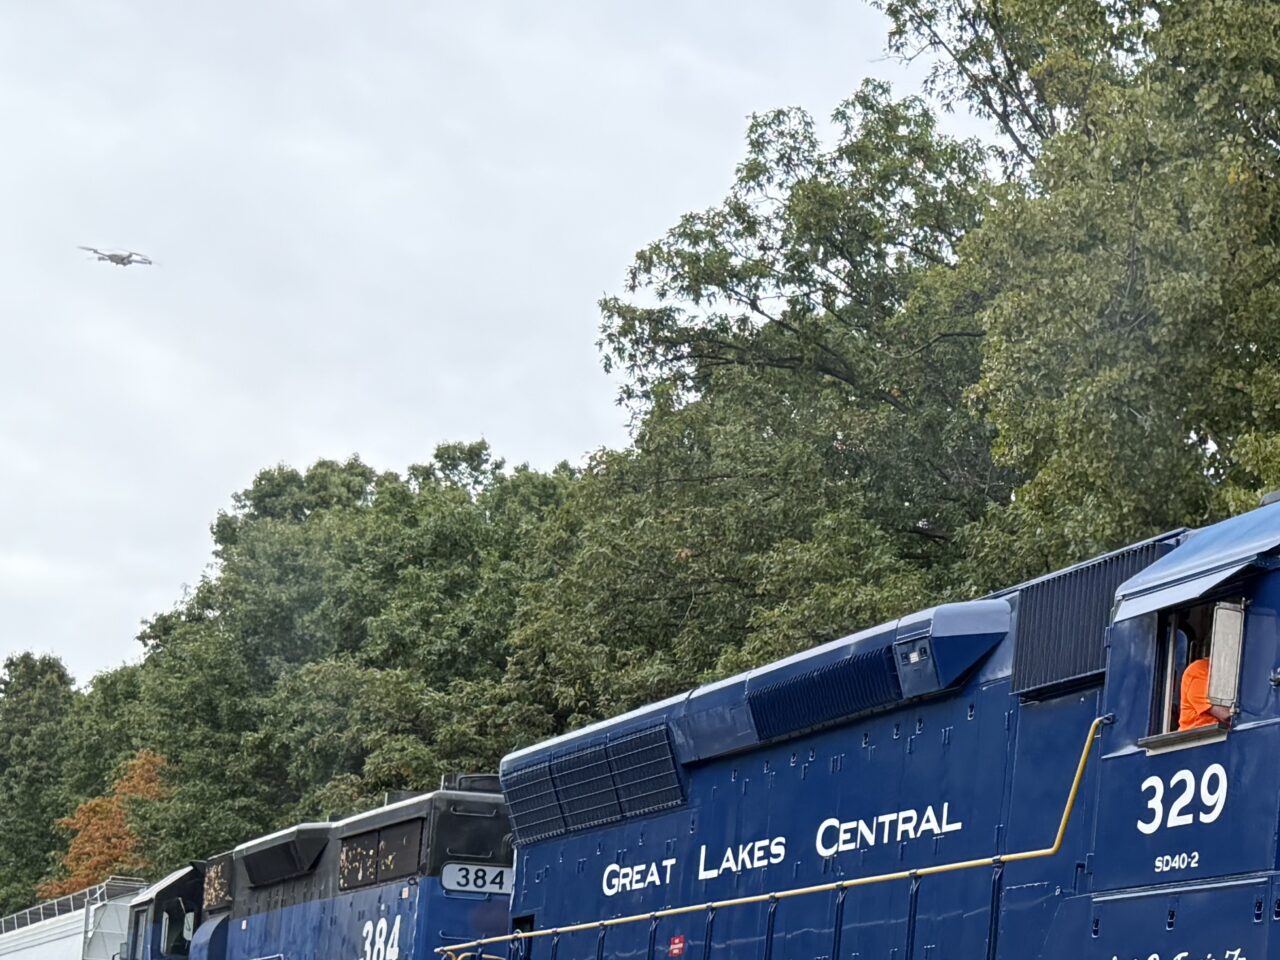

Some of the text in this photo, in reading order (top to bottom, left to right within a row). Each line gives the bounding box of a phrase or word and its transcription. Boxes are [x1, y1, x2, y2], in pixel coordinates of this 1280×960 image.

[1136, 763, 1228, 835] 329
[602, 802, 962, 897] GREAT LAKES CENTRAL
[1154, 851, 1200, 872] SD40-2
[456, 867, 505, 890] 384
